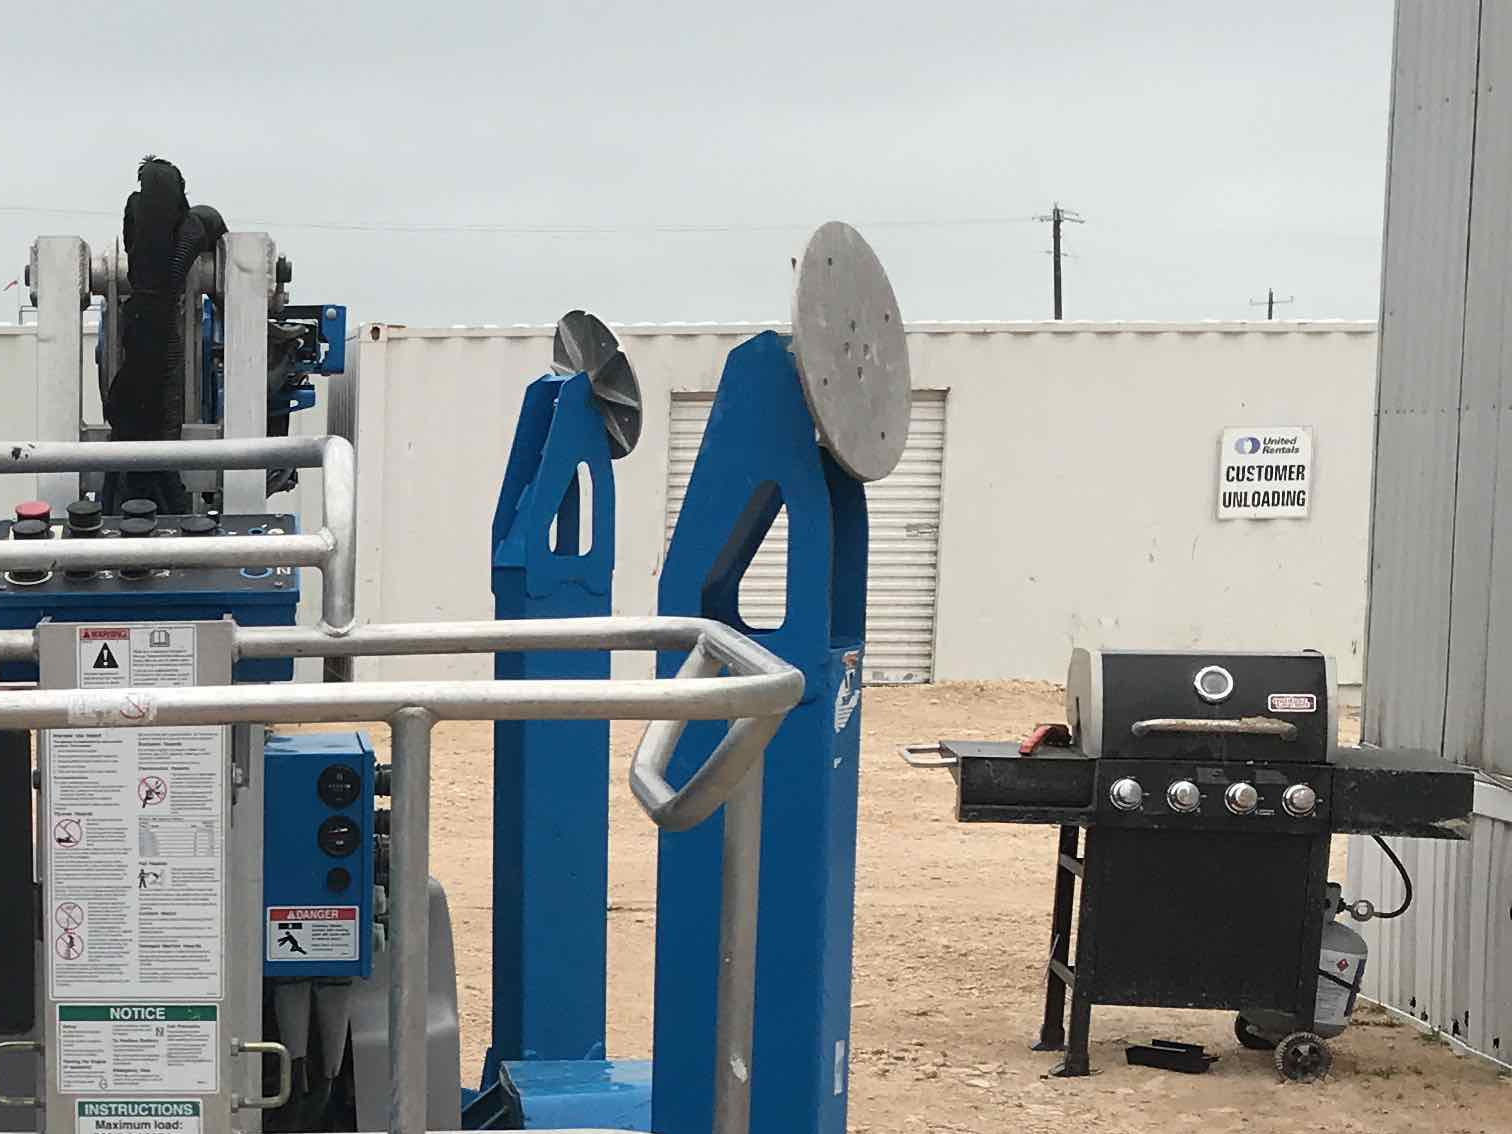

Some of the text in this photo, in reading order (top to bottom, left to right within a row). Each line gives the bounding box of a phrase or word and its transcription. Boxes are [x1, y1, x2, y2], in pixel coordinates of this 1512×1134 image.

[1262, 437, 1297, 445] United
[1262, 446, 1300, 454] Rentals
[1225, 464, 1306, 482] CUSTOMER
[1222, 489, 1307, 508] UNLOADING
[295, 909, 339, 919] DANGER
[109, 1007, 166, 1020] NOTICE
[84, 1103, 193, 1116] INSTRUCTIONS
[95, 1120, 184, 1130] Maximum load:
